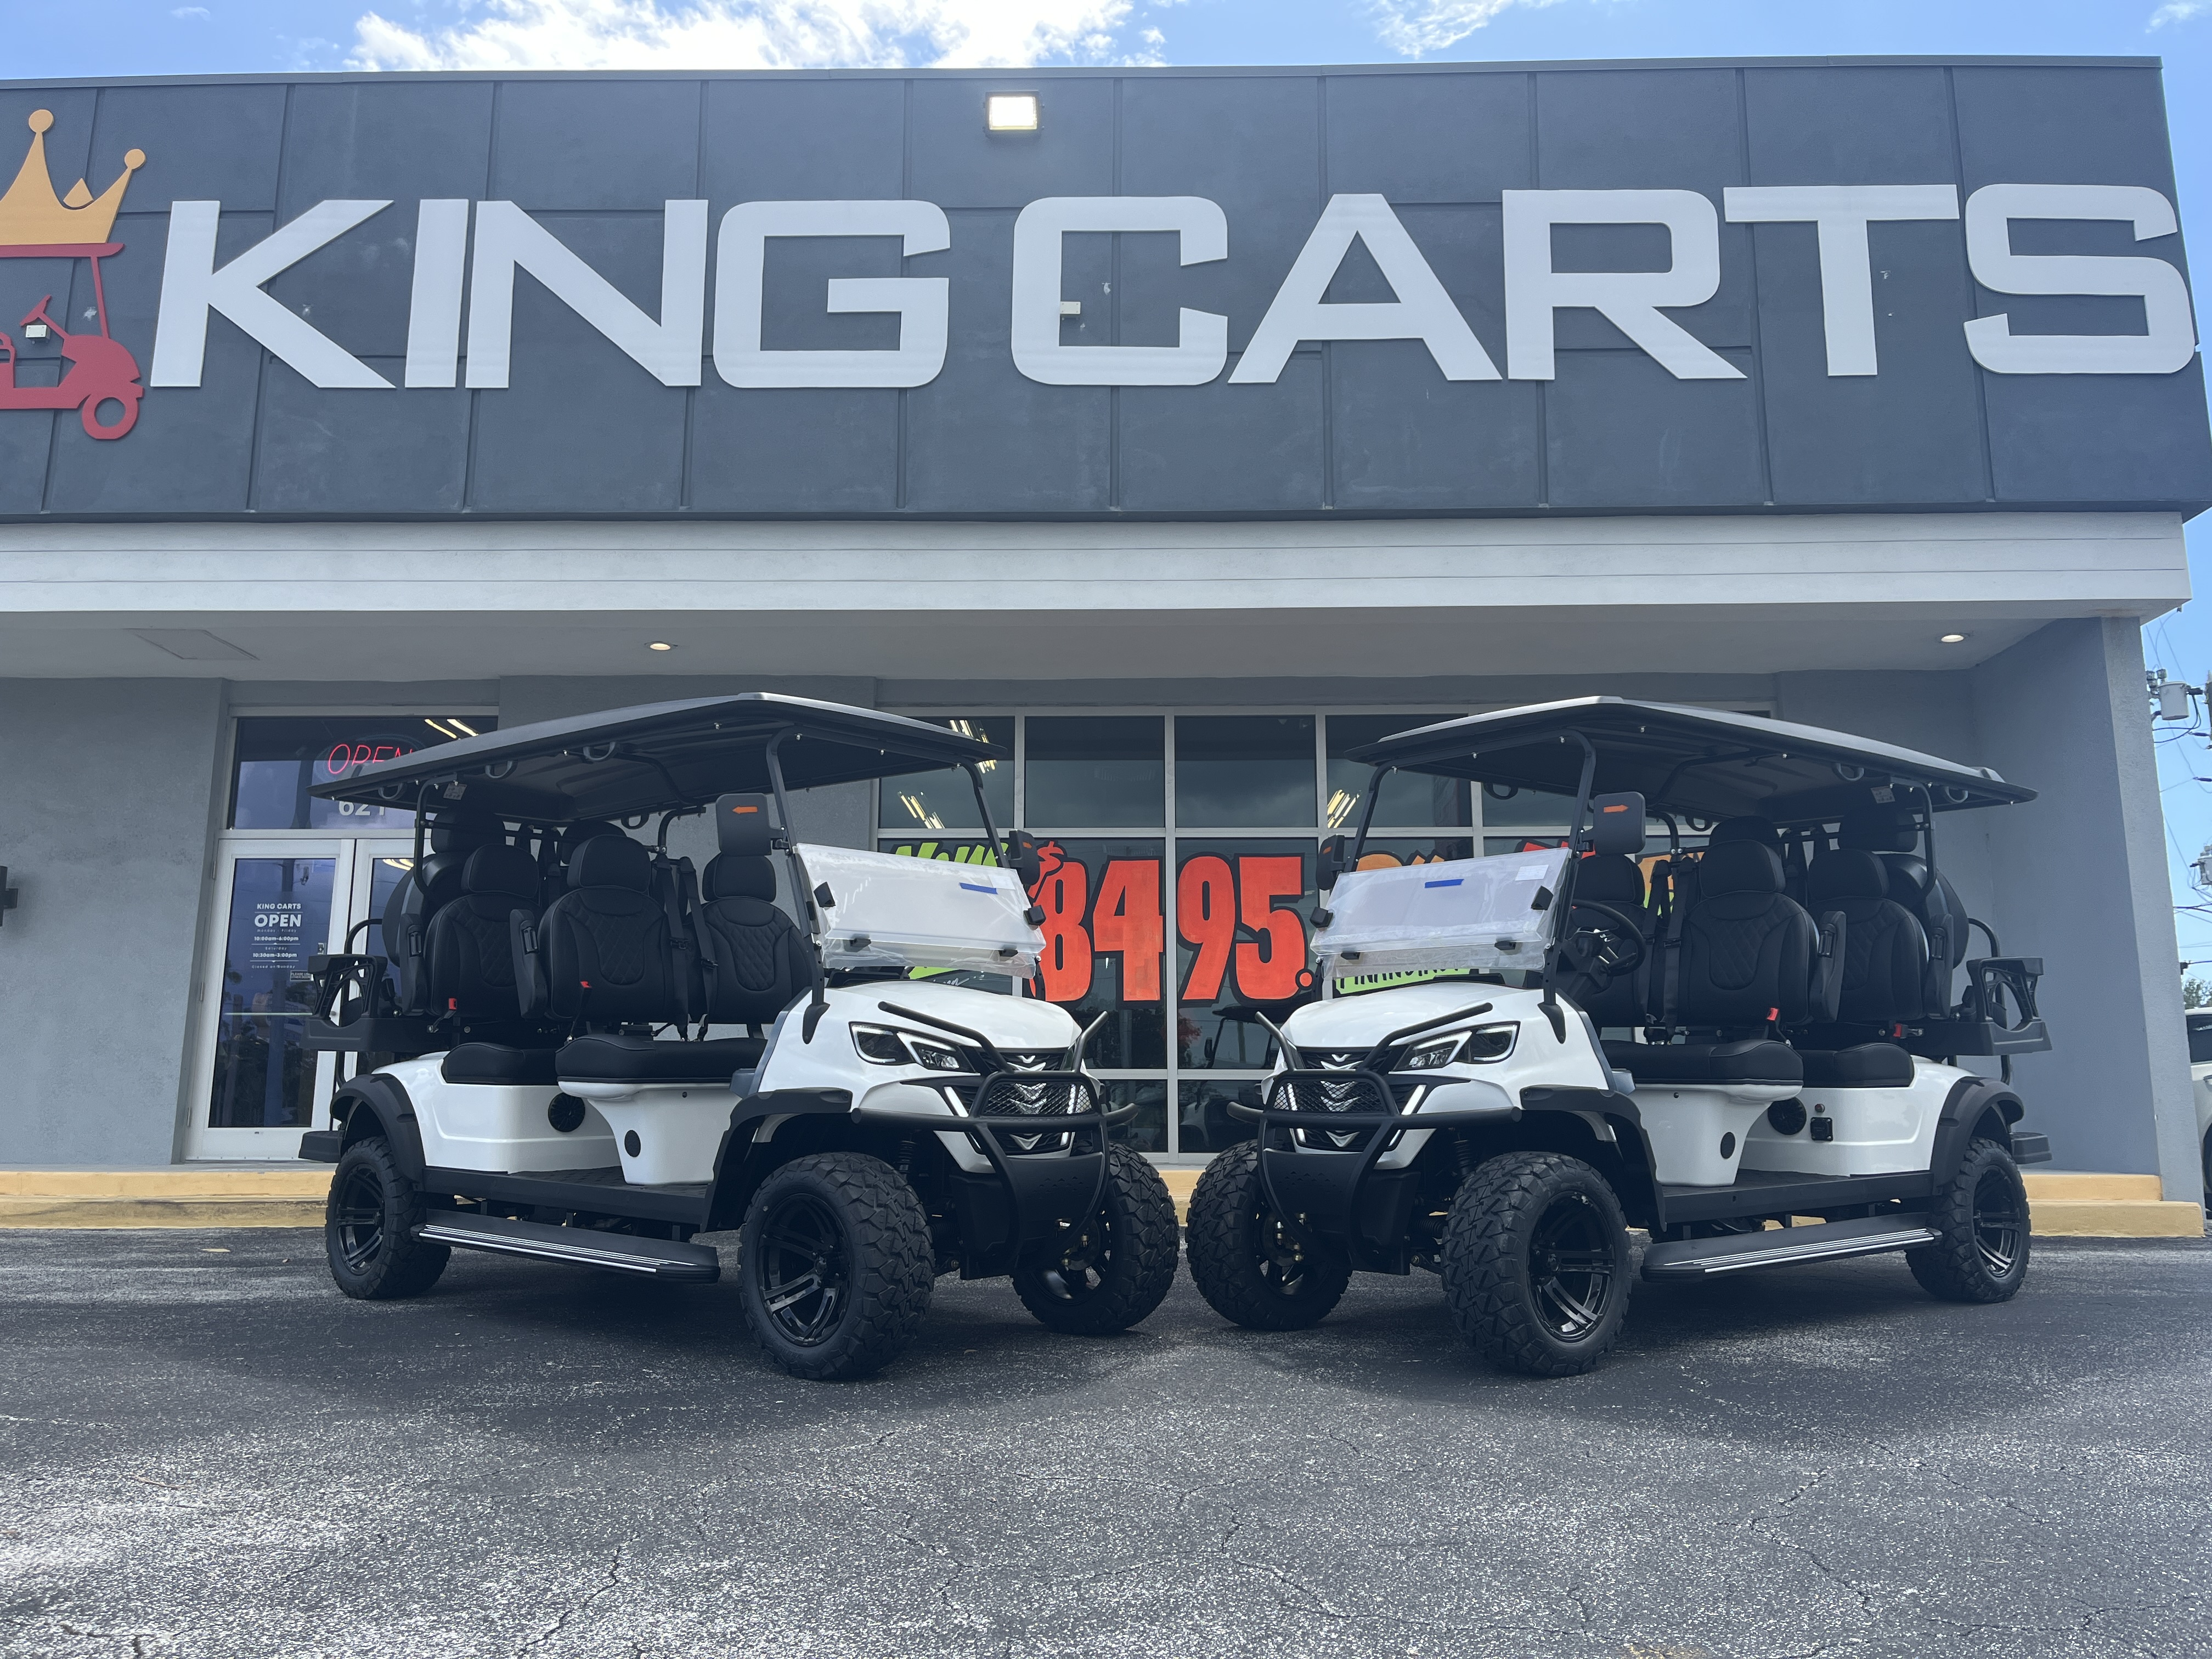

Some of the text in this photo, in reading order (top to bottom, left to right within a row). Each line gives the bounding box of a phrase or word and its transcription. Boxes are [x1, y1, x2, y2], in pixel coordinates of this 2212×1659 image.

[150, 184, 2196, 388] KING CARTS
[255, 914, 302, 927] OPEN
